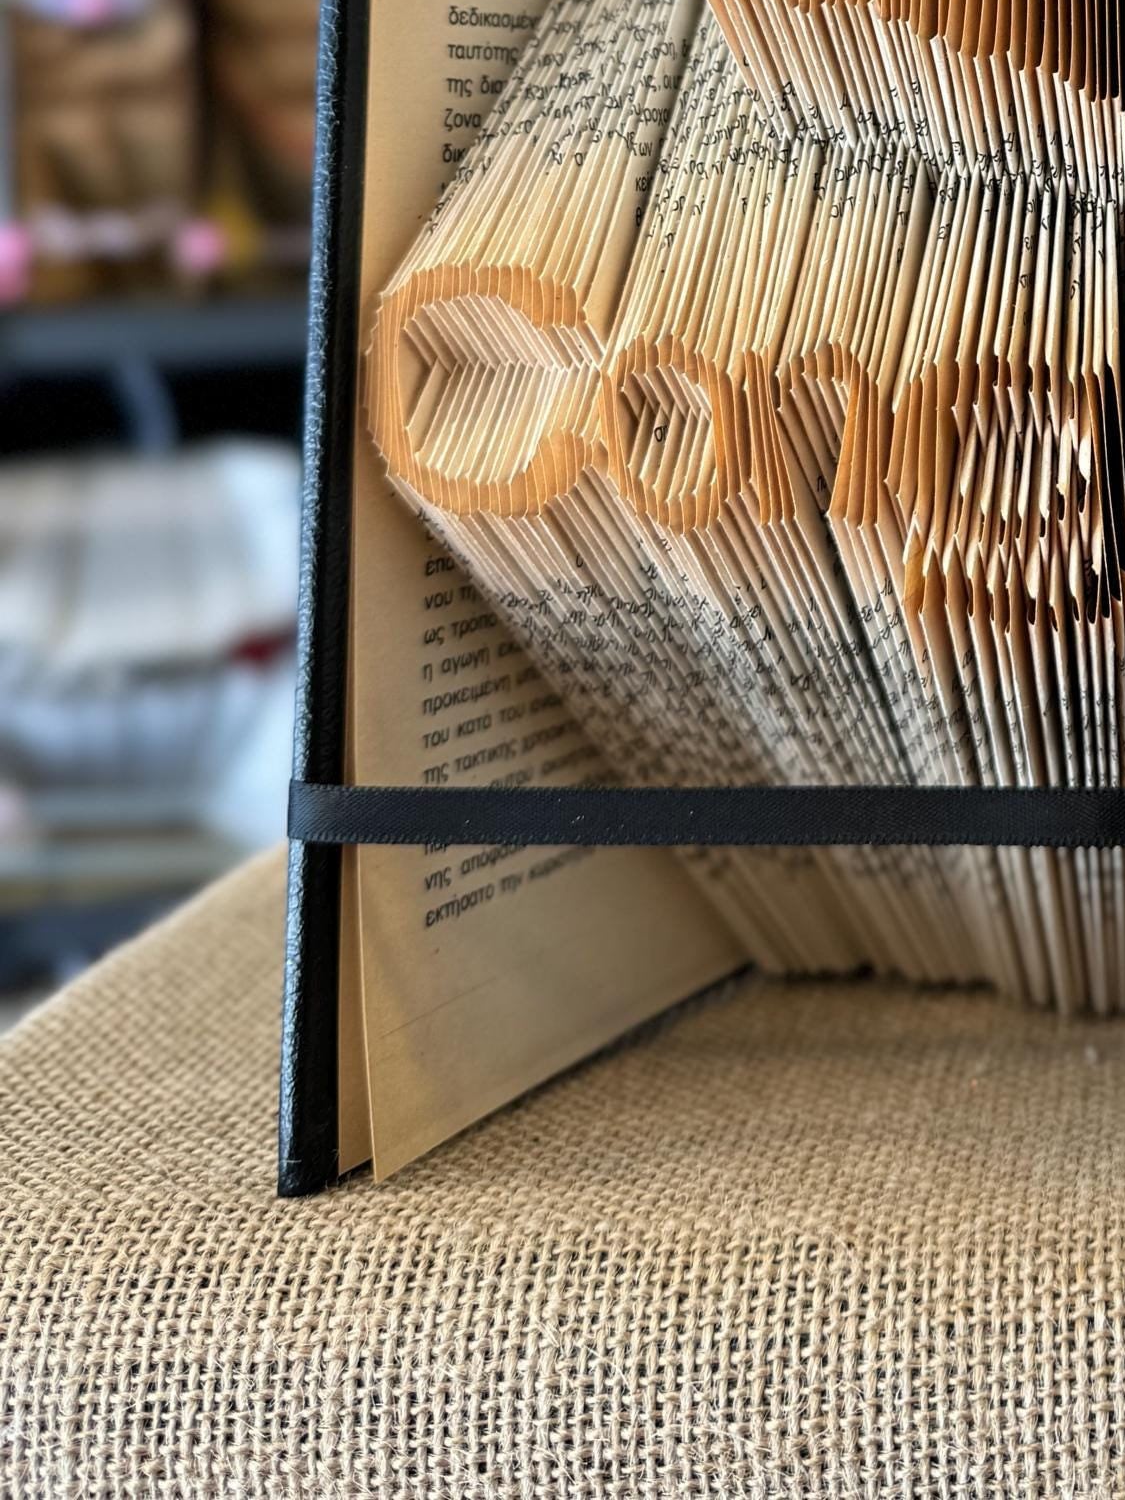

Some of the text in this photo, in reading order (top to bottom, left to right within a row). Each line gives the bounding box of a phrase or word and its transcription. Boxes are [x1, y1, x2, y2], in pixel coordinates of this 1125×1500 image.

[446, 77, 473, 97] της
[424, 590, 454, 610] νου
[424, 626, 445, 646] ως
[423, 663, 434, 684] η
[441, 644, 490, 674] αγωγή
[423, 730, 450, 750] του
[424, 762, 449, 786] της
[424, 864, 451, 892] νης
[425, 880, 495, 929] εκτήσατο
